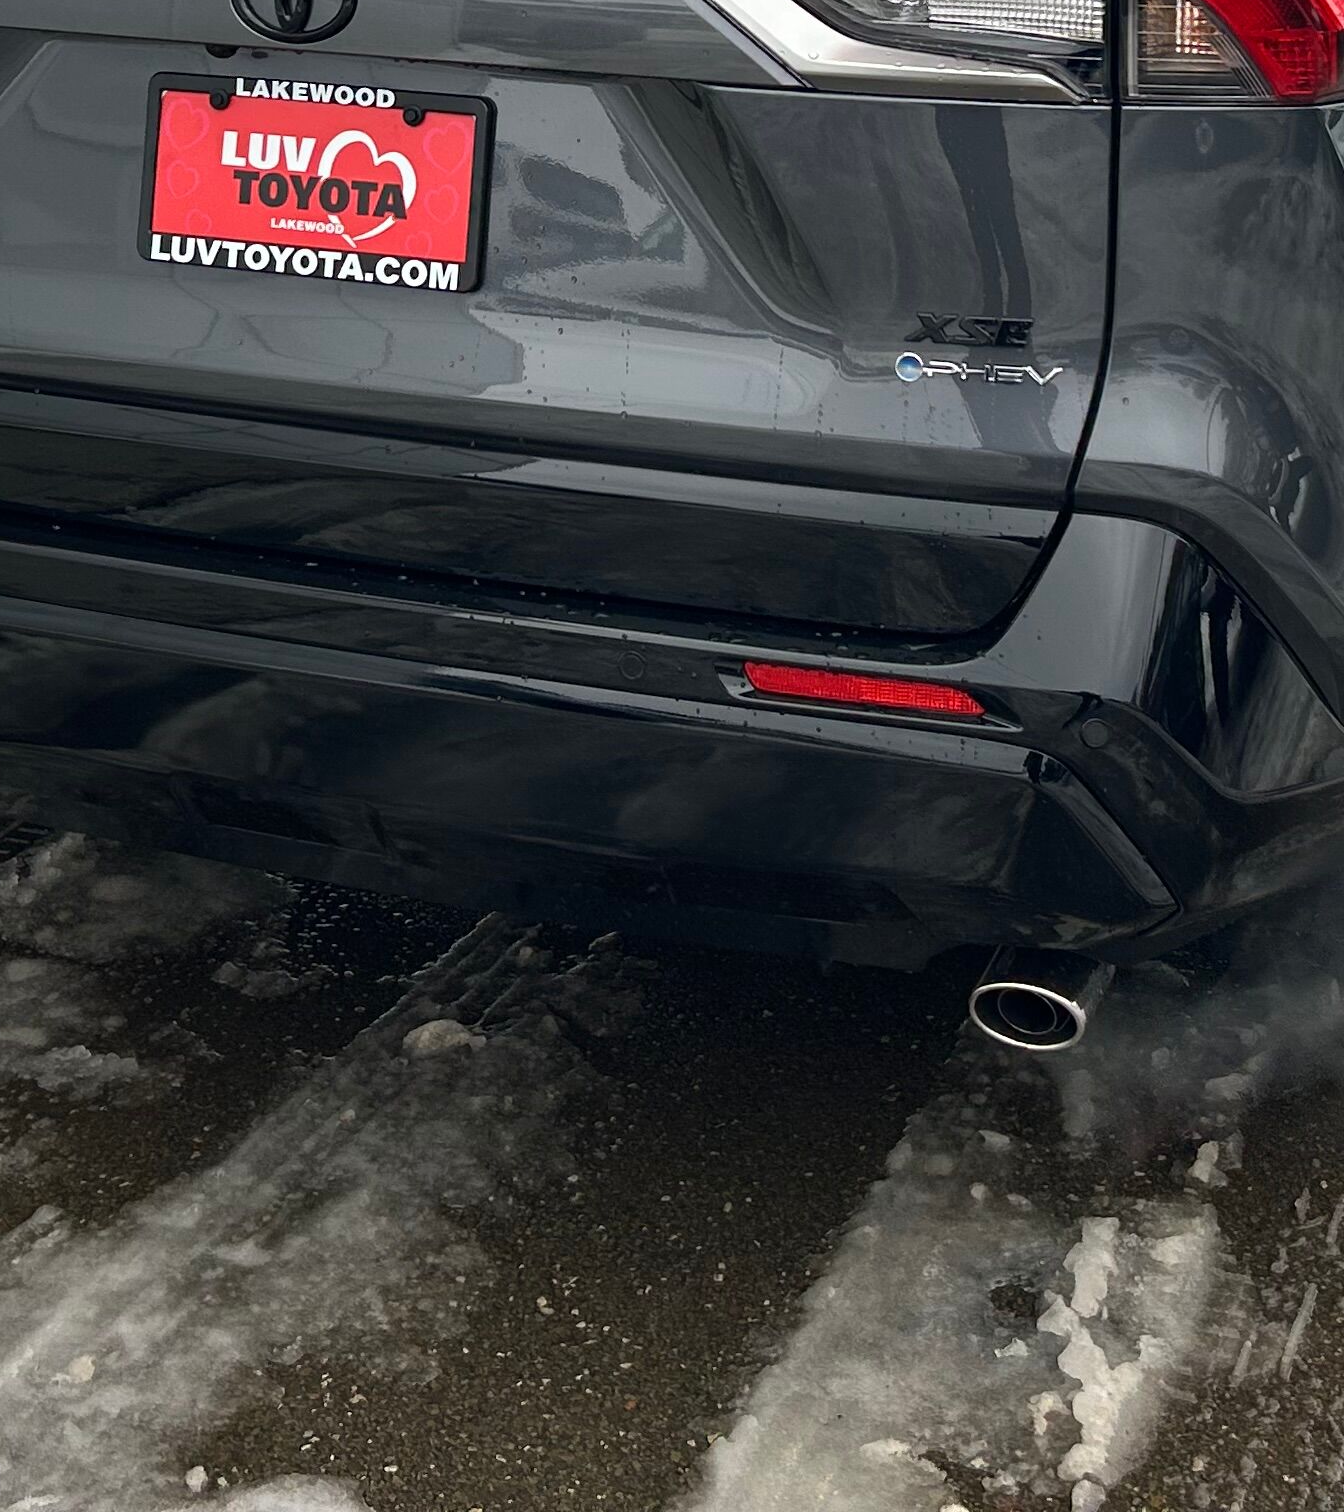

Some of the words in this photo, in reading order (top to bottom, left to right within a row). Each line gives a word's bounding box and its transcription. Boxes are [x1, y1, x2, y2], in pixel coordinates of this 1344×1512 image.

[235, 77, 395, 109] LAKEWOOD
[221, 130, 316, 173] LUV
[233, 169, 407, 220] TOYOTA
[270, 217, 345, 235] LAKEWOOD
[150, 234, 460, 291] LUVTOYOTA.COM
